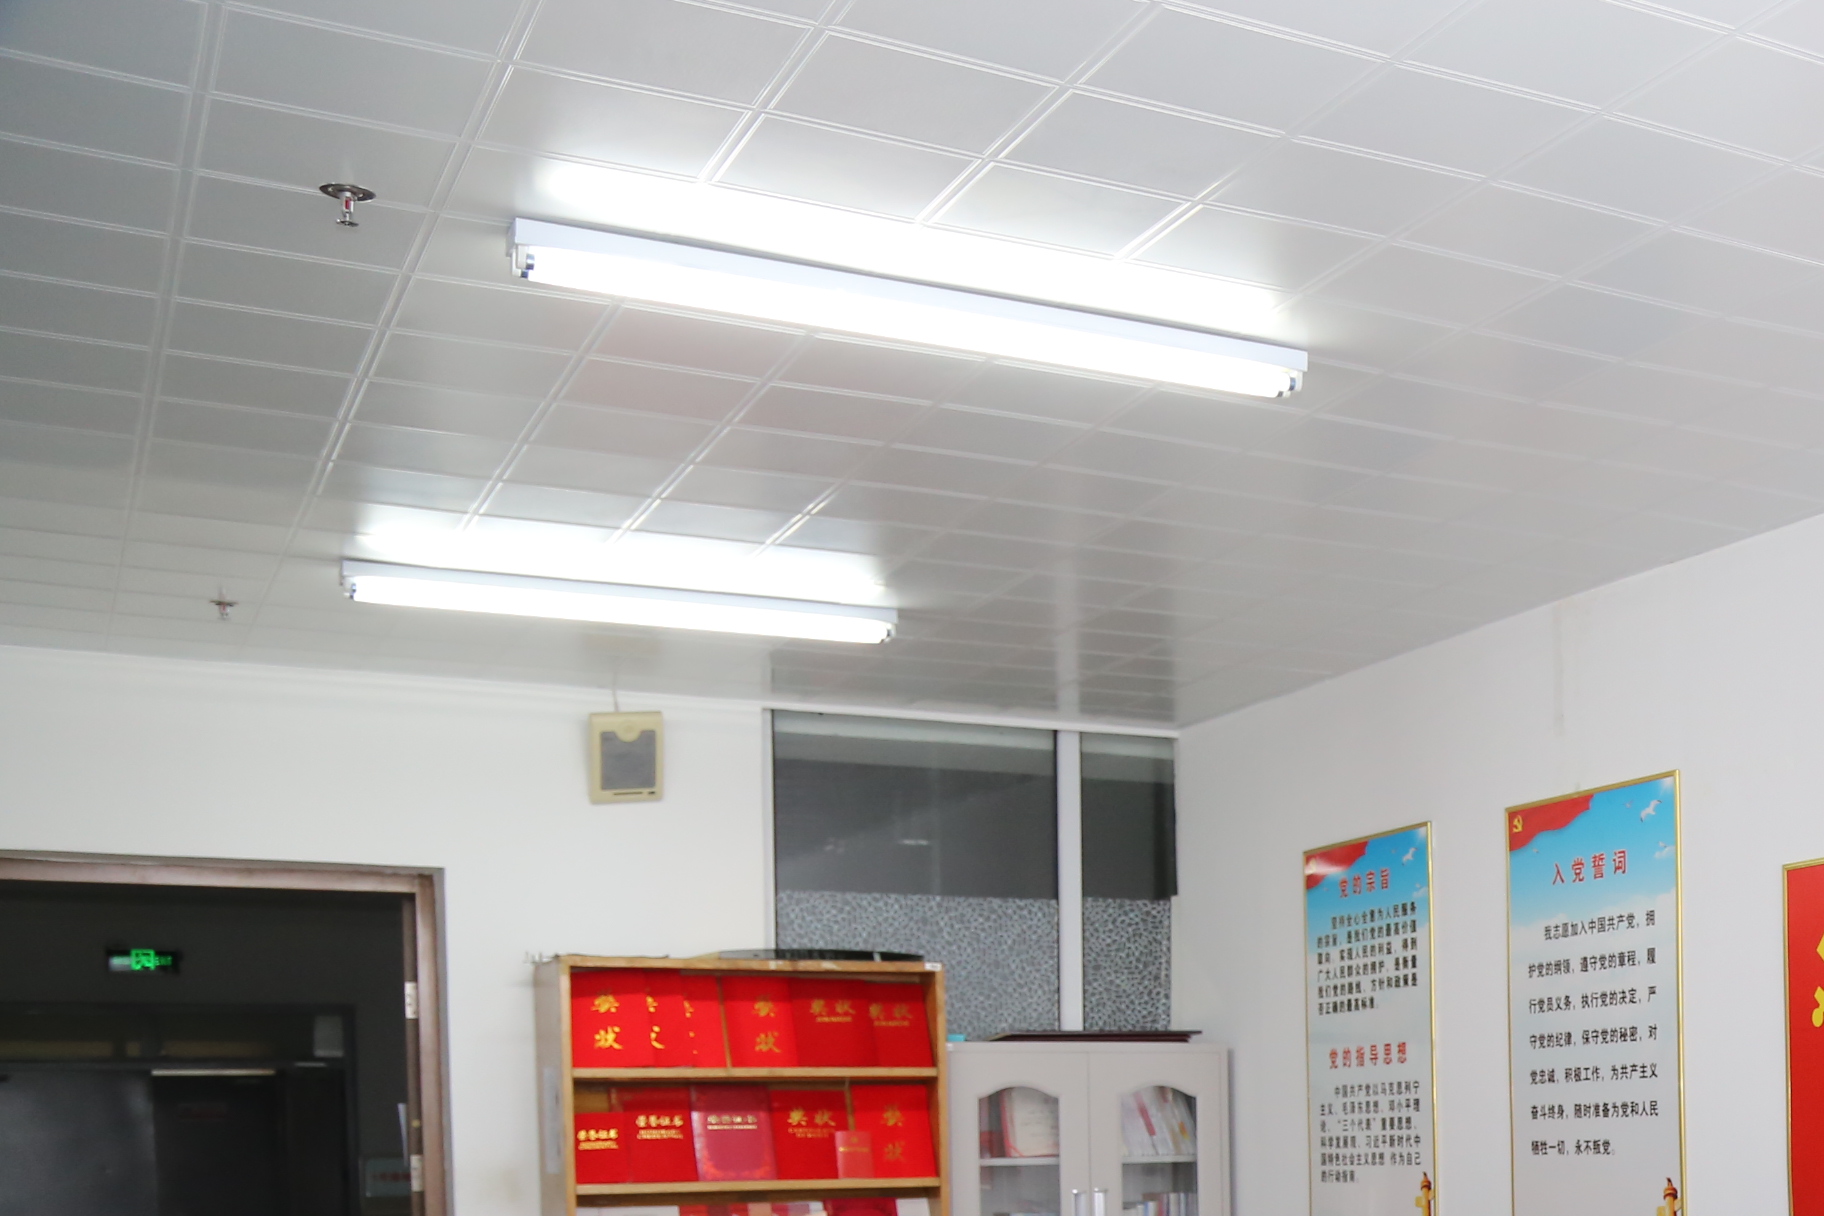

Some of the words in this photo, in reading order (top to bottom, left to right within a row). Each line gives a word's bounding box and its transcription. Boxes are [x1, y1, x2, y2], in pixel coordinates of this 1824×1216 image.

[1338, 867, 1390, 898] 党的宗旨
[1552, 849, 1628, 886] 入党誓词
[1544, 909, 1656, 941] 我志愿加入中国共产党，拥
[1329, 1041, 1407, 1070] 党的指导思想
[1531, 1138, 1616, 1157] 牺牲一切，永不叛党。
